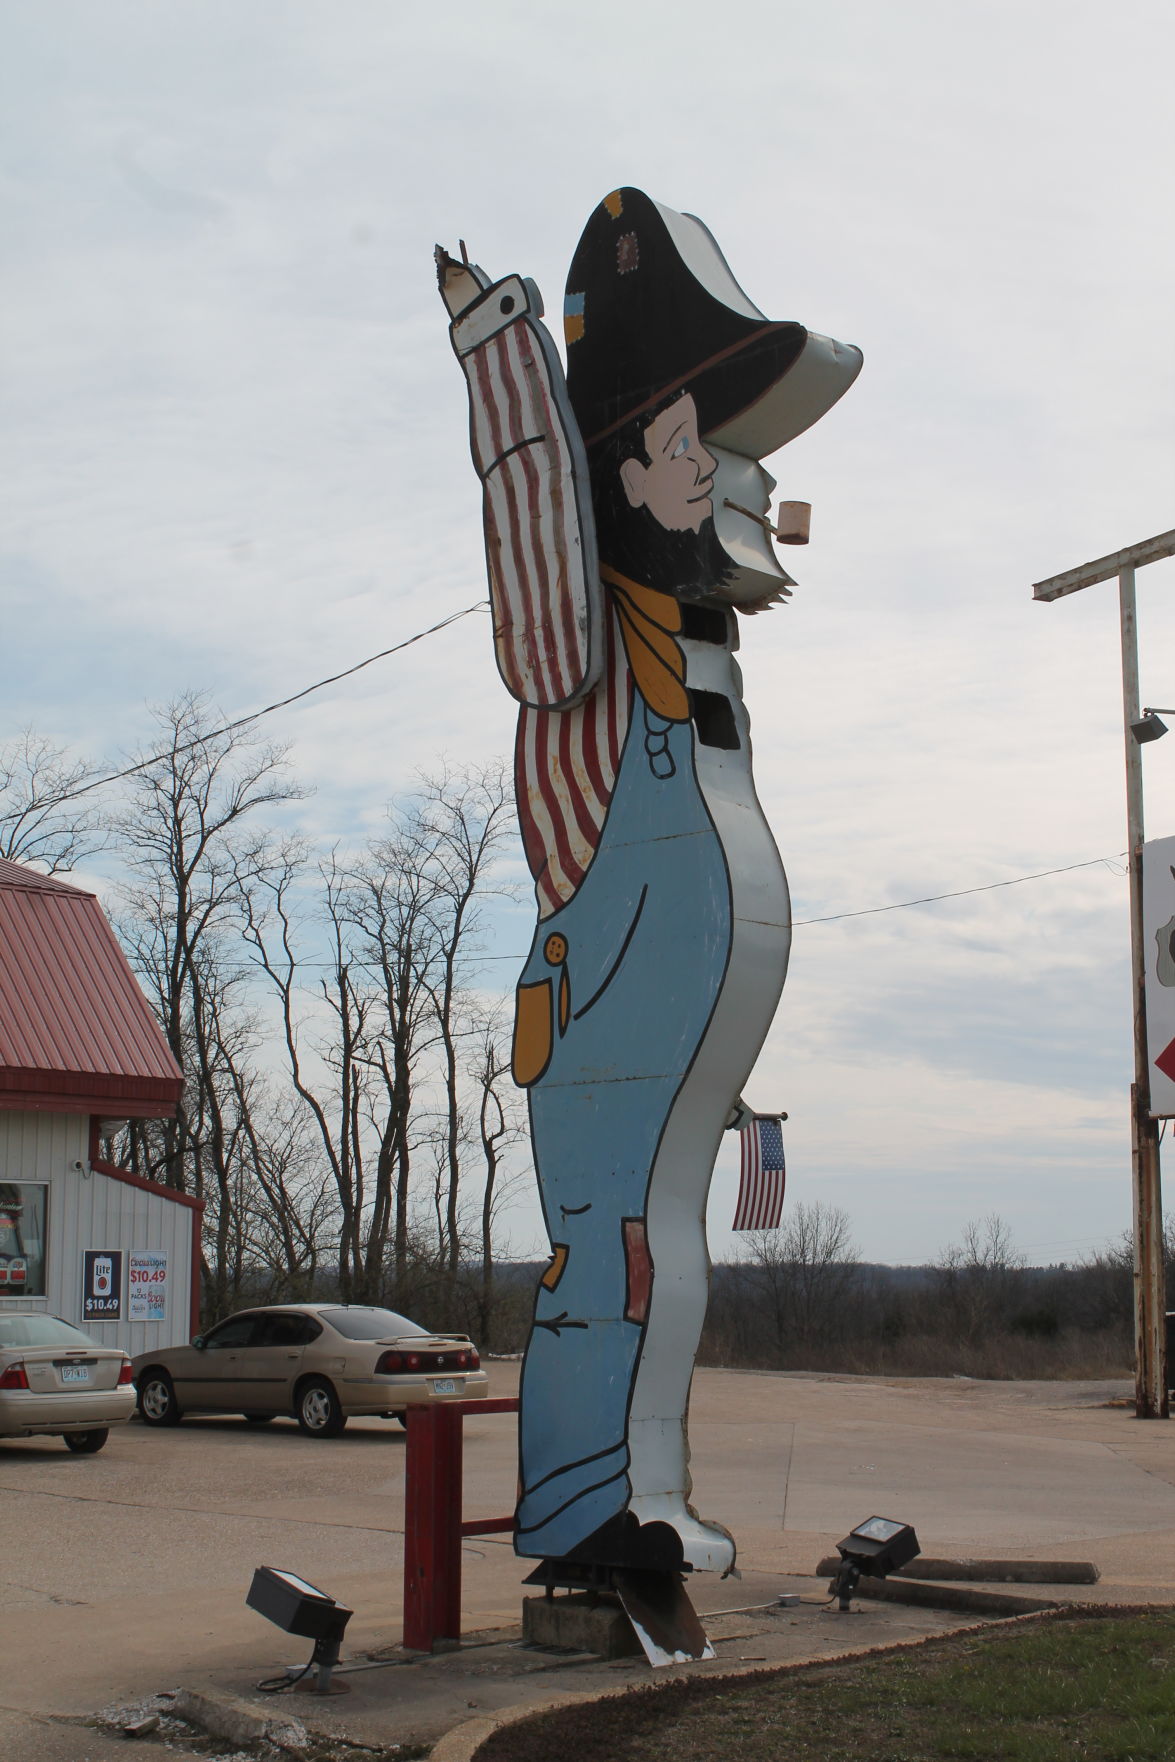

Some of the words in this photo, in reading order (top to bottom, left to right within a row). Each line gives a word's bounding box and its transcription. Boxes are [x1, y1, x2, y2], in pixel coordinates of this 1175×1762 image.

[96, 1265, 111, 1276] Lite
[130, 1270, 166, 1283] $10.49
[86, 1297, 119, 1311] $10.49
